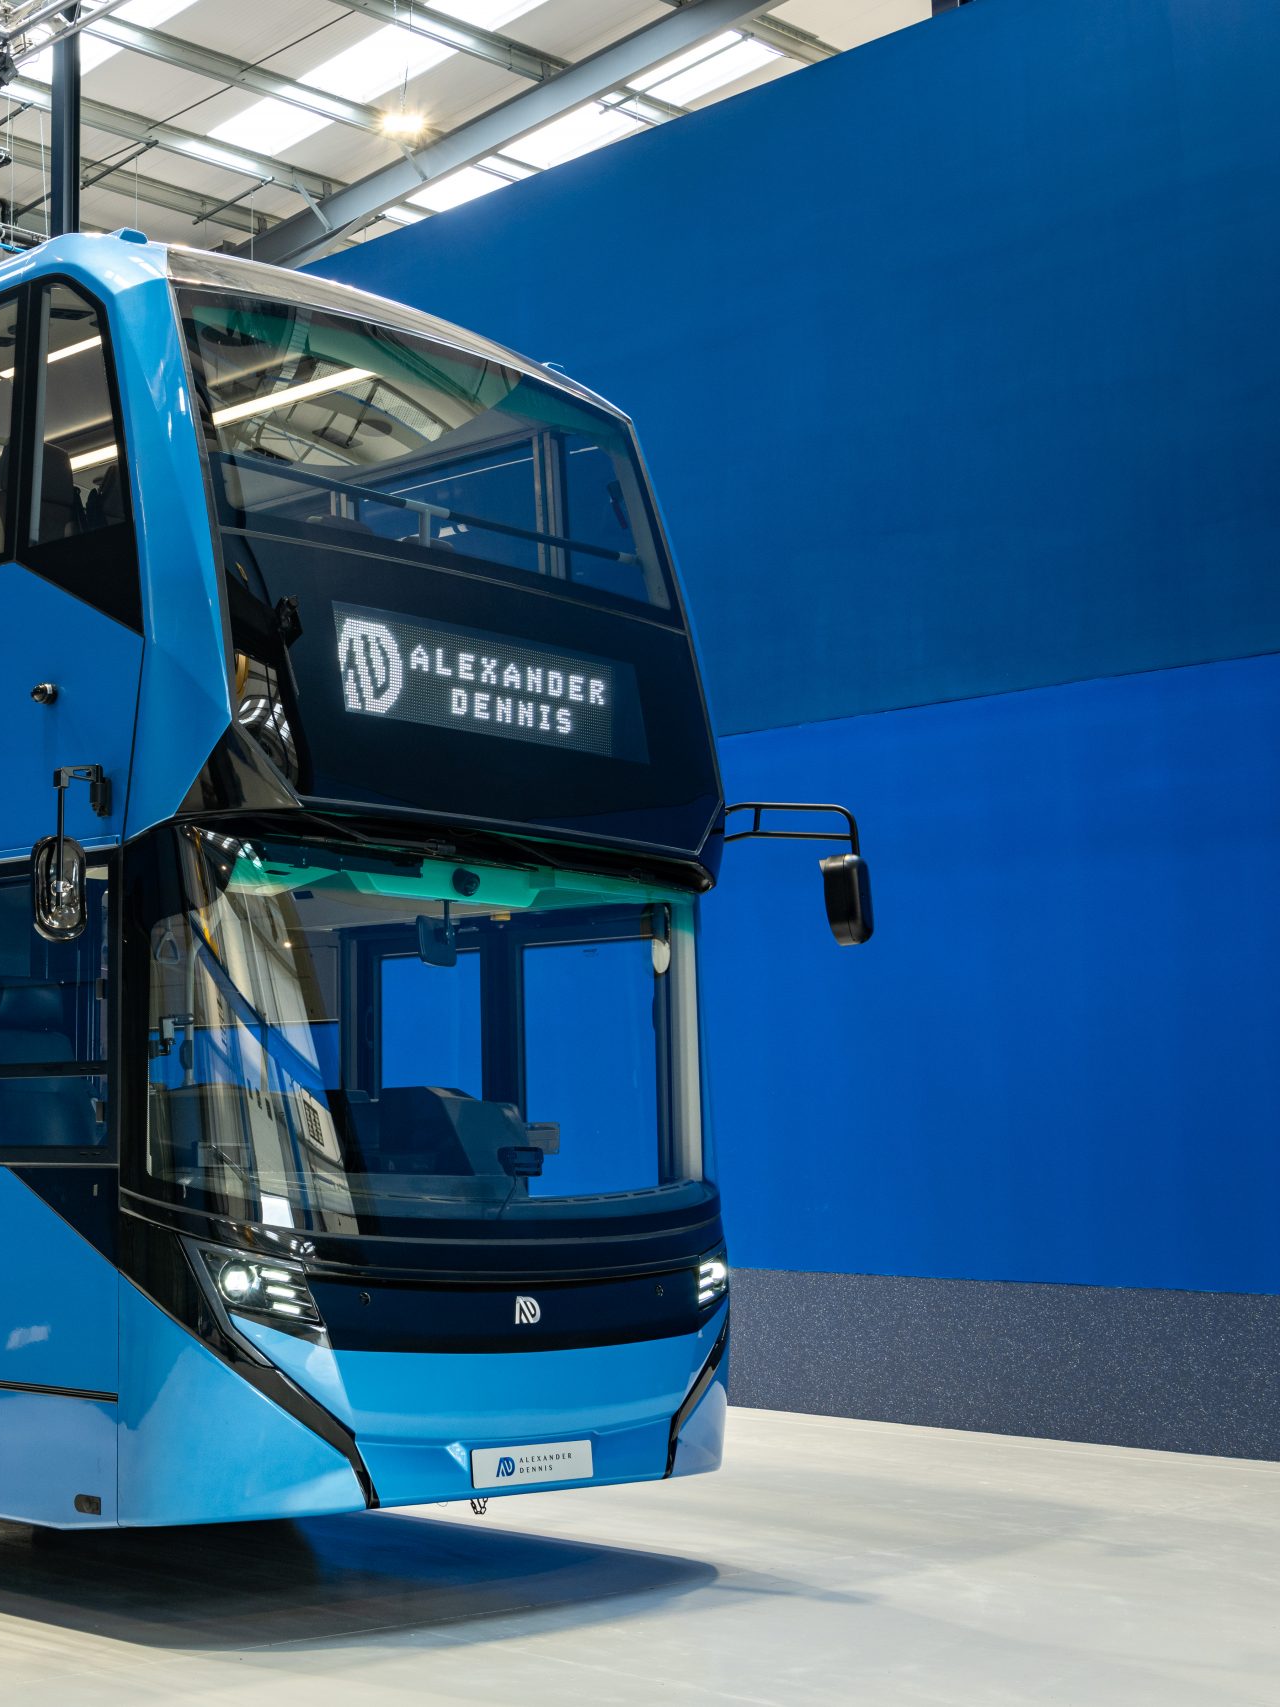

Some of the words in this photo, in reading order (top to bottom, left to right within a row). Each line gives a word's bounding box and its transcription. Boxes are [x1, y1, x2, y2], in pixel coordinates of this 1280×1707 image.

[410, 645, 605, 705] ALEXANDER
[451, 688, 572, 734] DENNIS
[519, 1452, 573, 1464] ALEXANDER
[519, 1464, 554, 1474] DENNIS
